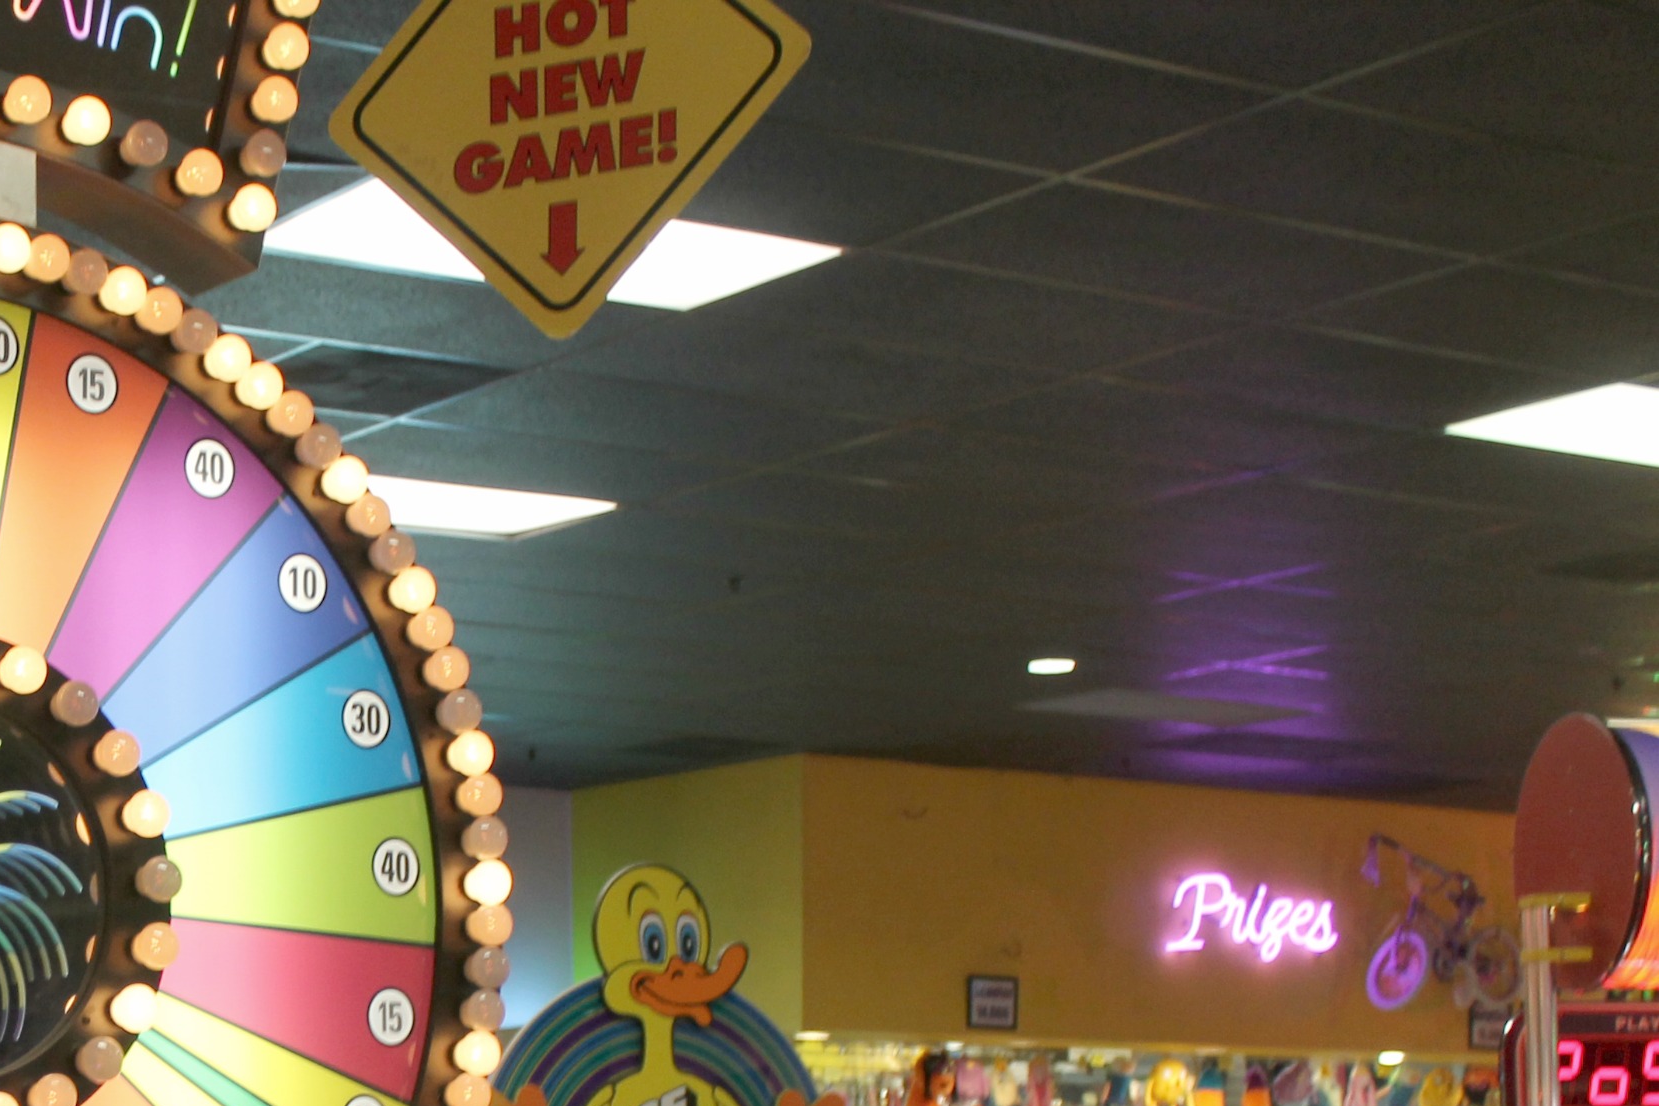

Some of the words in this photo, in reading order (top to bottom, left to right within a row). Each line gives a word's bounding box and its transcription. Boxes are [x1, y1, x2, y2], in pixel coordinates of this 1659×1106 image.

[494, 0, 634, 59] HOT
[489, 47, 646, 126] NEW
[454, 108, 678, 194] GAME!
[78, 368, 105, 401] 15
[195, 451, 224, 483] 40
[289, 567, 317, 600] 10
[351, 703, 381, 736] 30
[381, 851, 410, 884] 40
[1164, 870, 1339, 962] Prizes
[379, 1002, 402, 1032] 15
